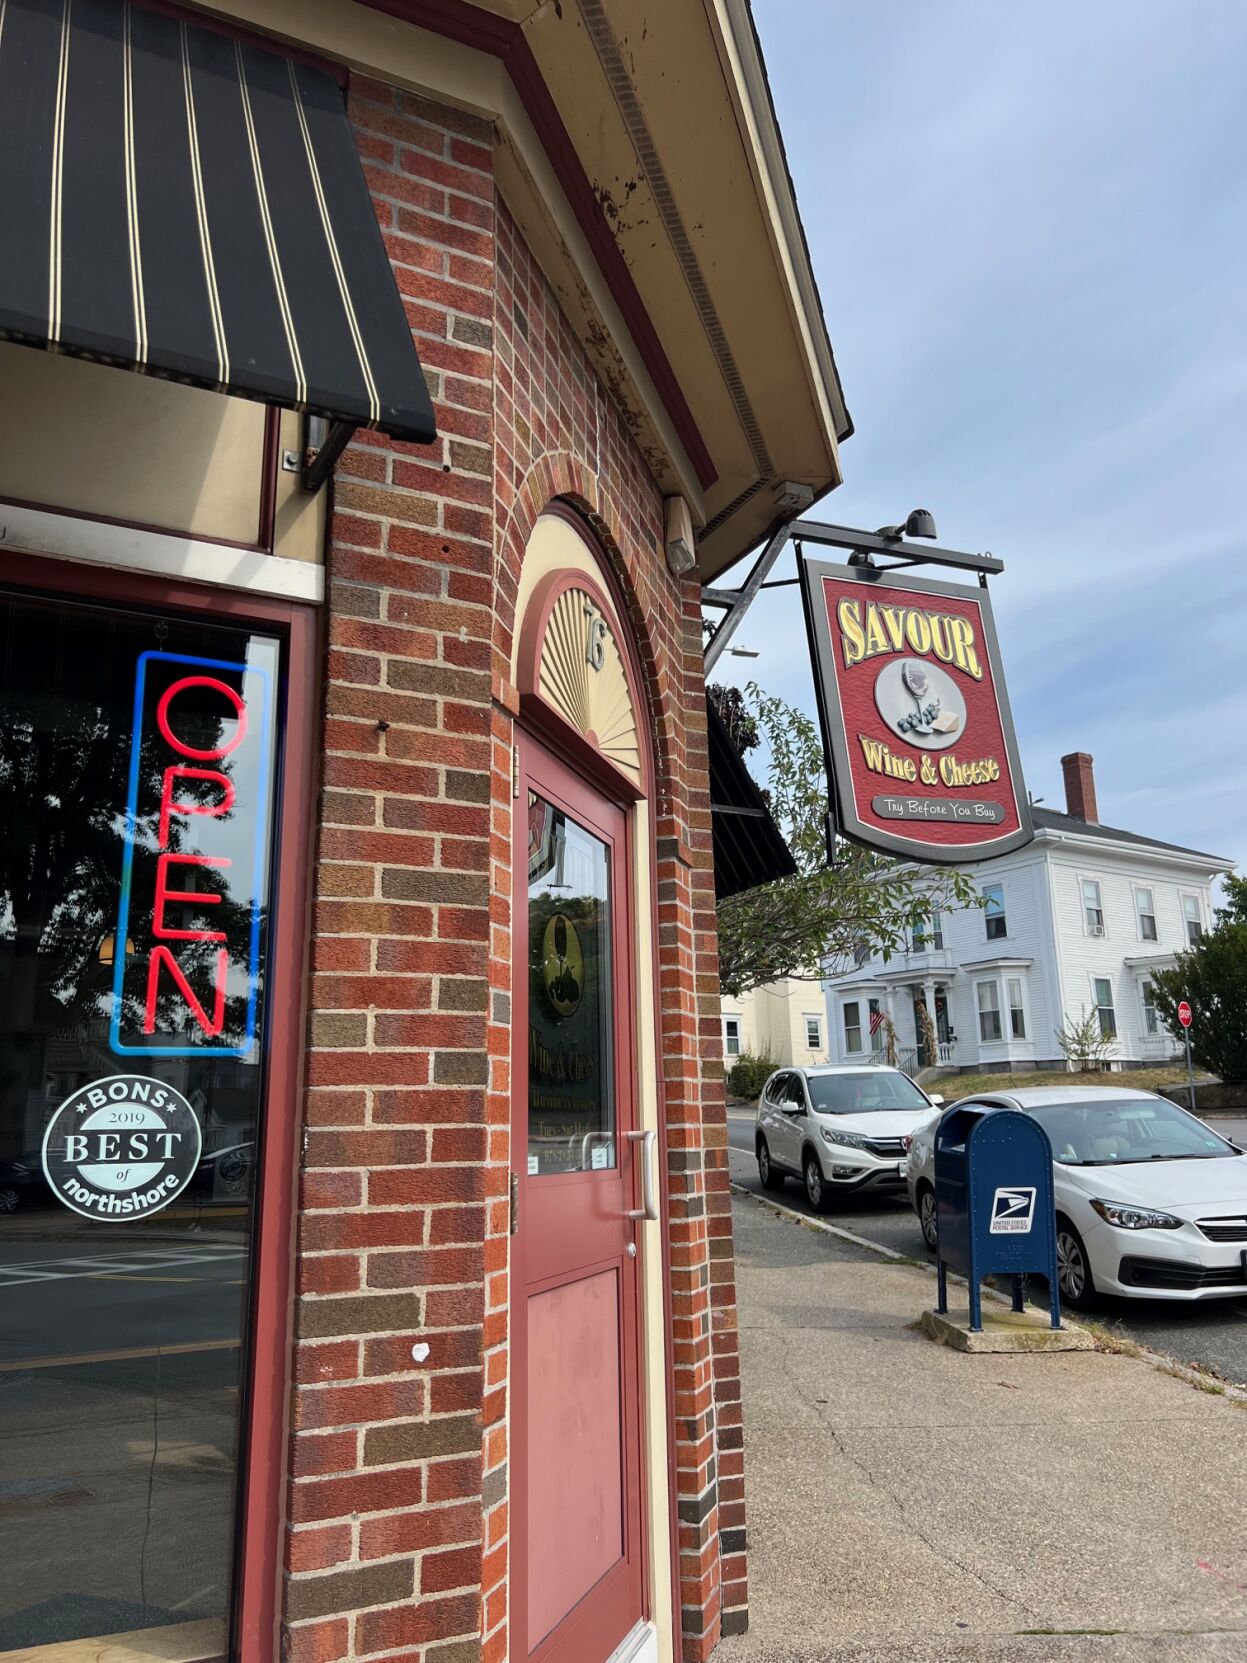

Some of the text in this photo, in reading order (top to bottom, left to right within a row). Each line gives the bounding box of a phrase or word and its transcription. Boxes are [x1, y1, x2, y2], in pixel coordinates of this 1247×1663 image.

[838, 598, 983, 680] SAVOUR
[858, 735, 1000, 787] Wine & Cheese
[884, 799, 996, 820] Try Before You Buy
[144, 675, 248, 1037] OPEN
[86, 1081, 169, 1109] BONS
[109, 1112, 145, 1124] 2019
[63, 1133, 182, 1162] BEST
[116, 1169, 132, 1182] of
[63, 1173, 180, 1213] northshore
